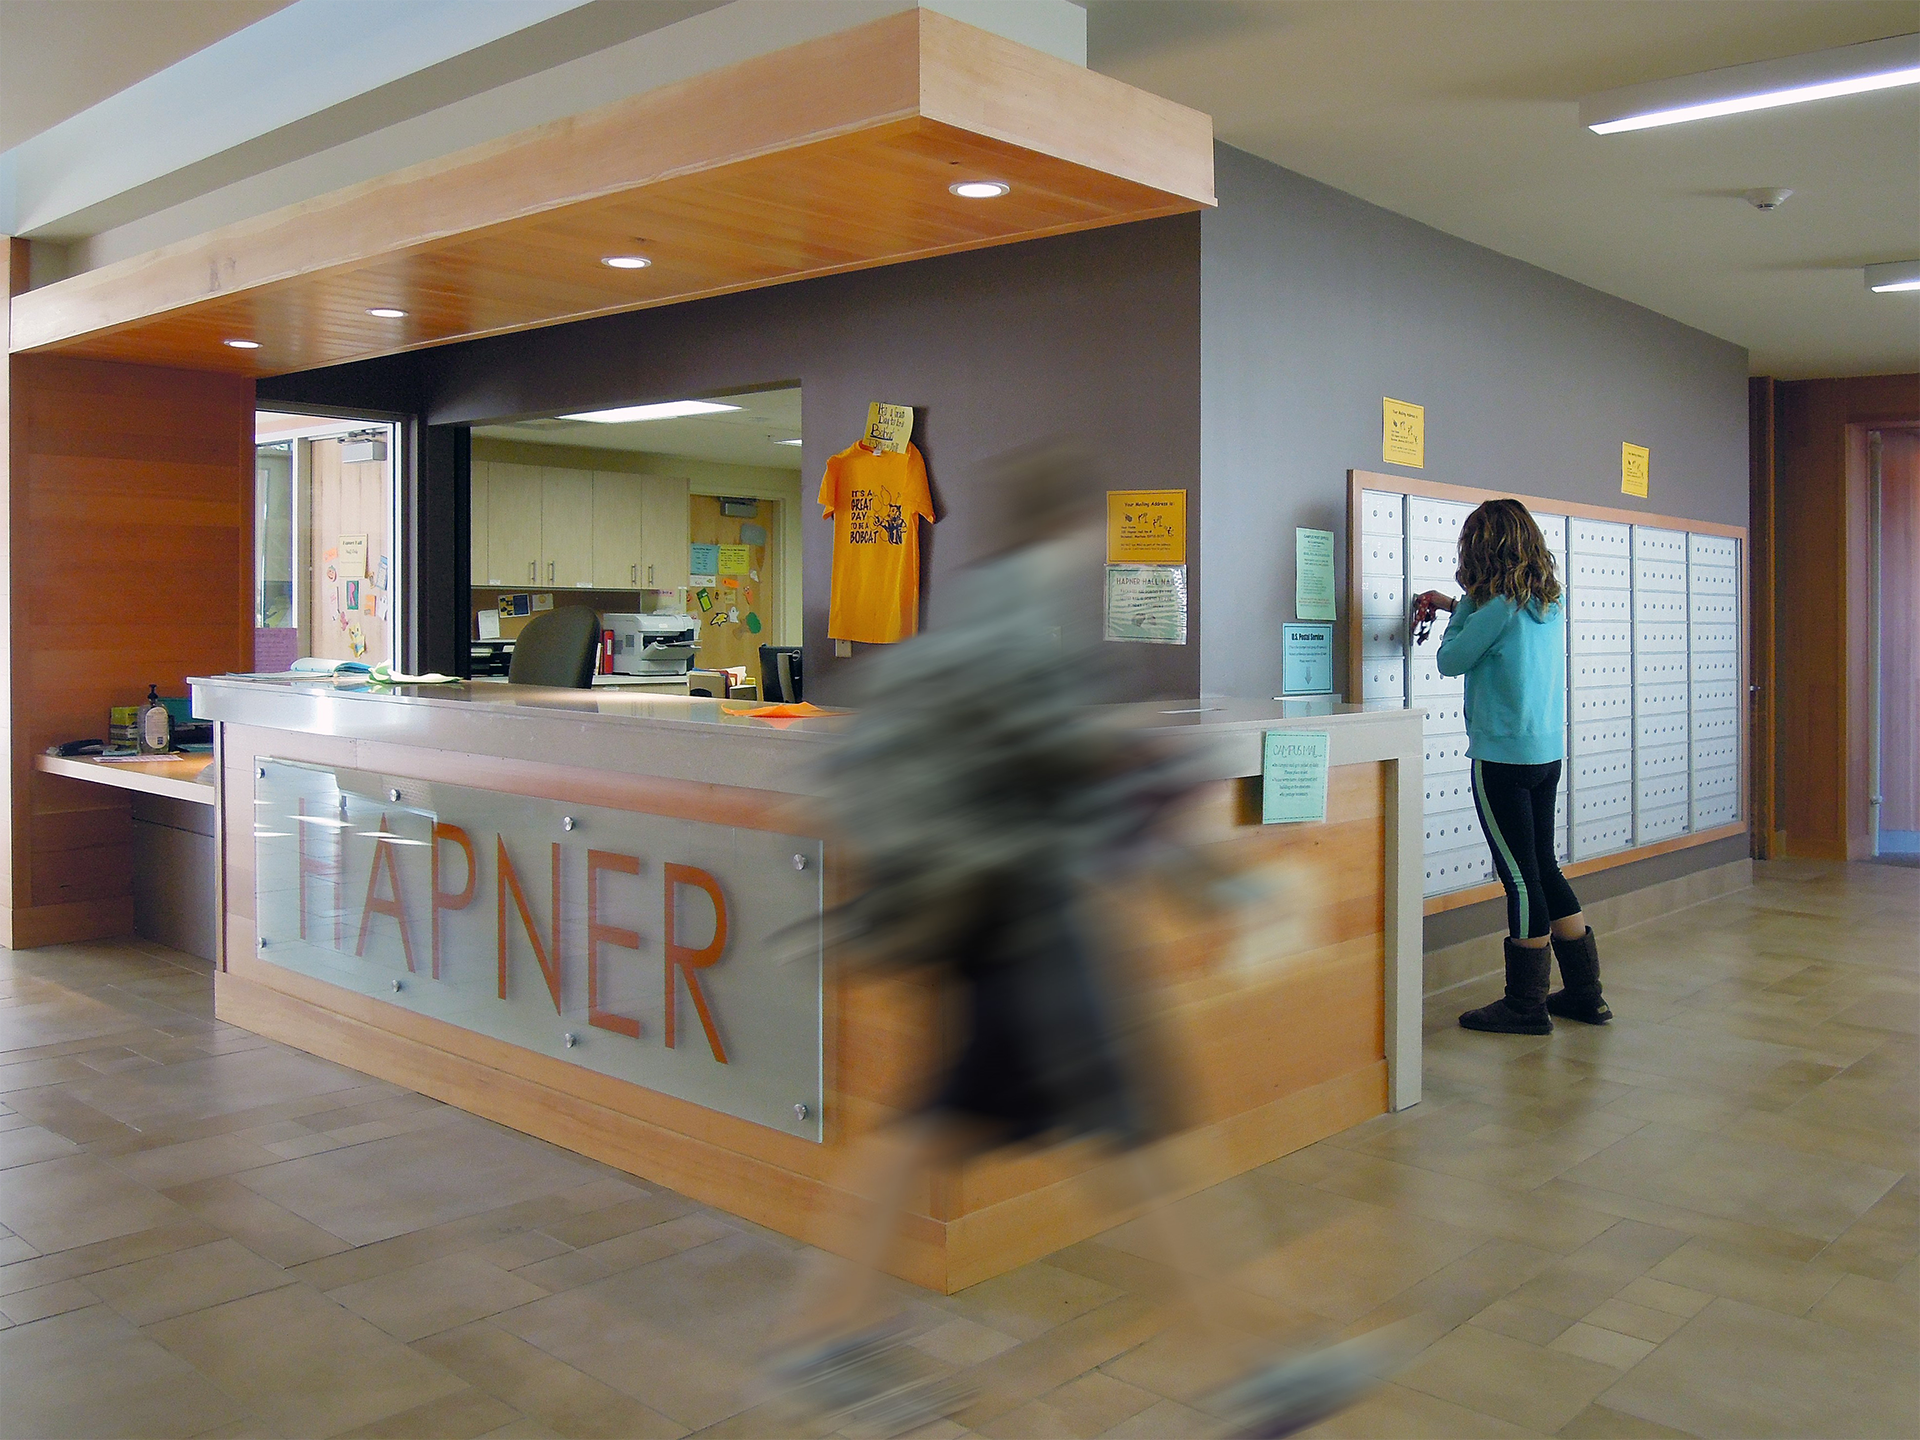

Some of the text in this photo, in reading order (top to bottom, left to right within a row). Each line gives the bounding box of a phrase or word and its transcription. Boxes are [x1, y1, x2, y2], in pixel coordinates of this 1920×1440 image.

[851, 489, 873, 498] IT'S A
[851, 498, 873, 511] GREAT
[851, 512, 868, 521] DAY
[851, 522, 857, 530] TO
[850, 530, 879, 544] BOBCAT
[1116, 577, 1141, 586] HAPNER
[1143, 577, 1159, 586] HALL
[1299, 632, 1310, 641] Postal
[1310, 632, 1325, 641] Service
[299, 796, 729, 1065] HAPNER
